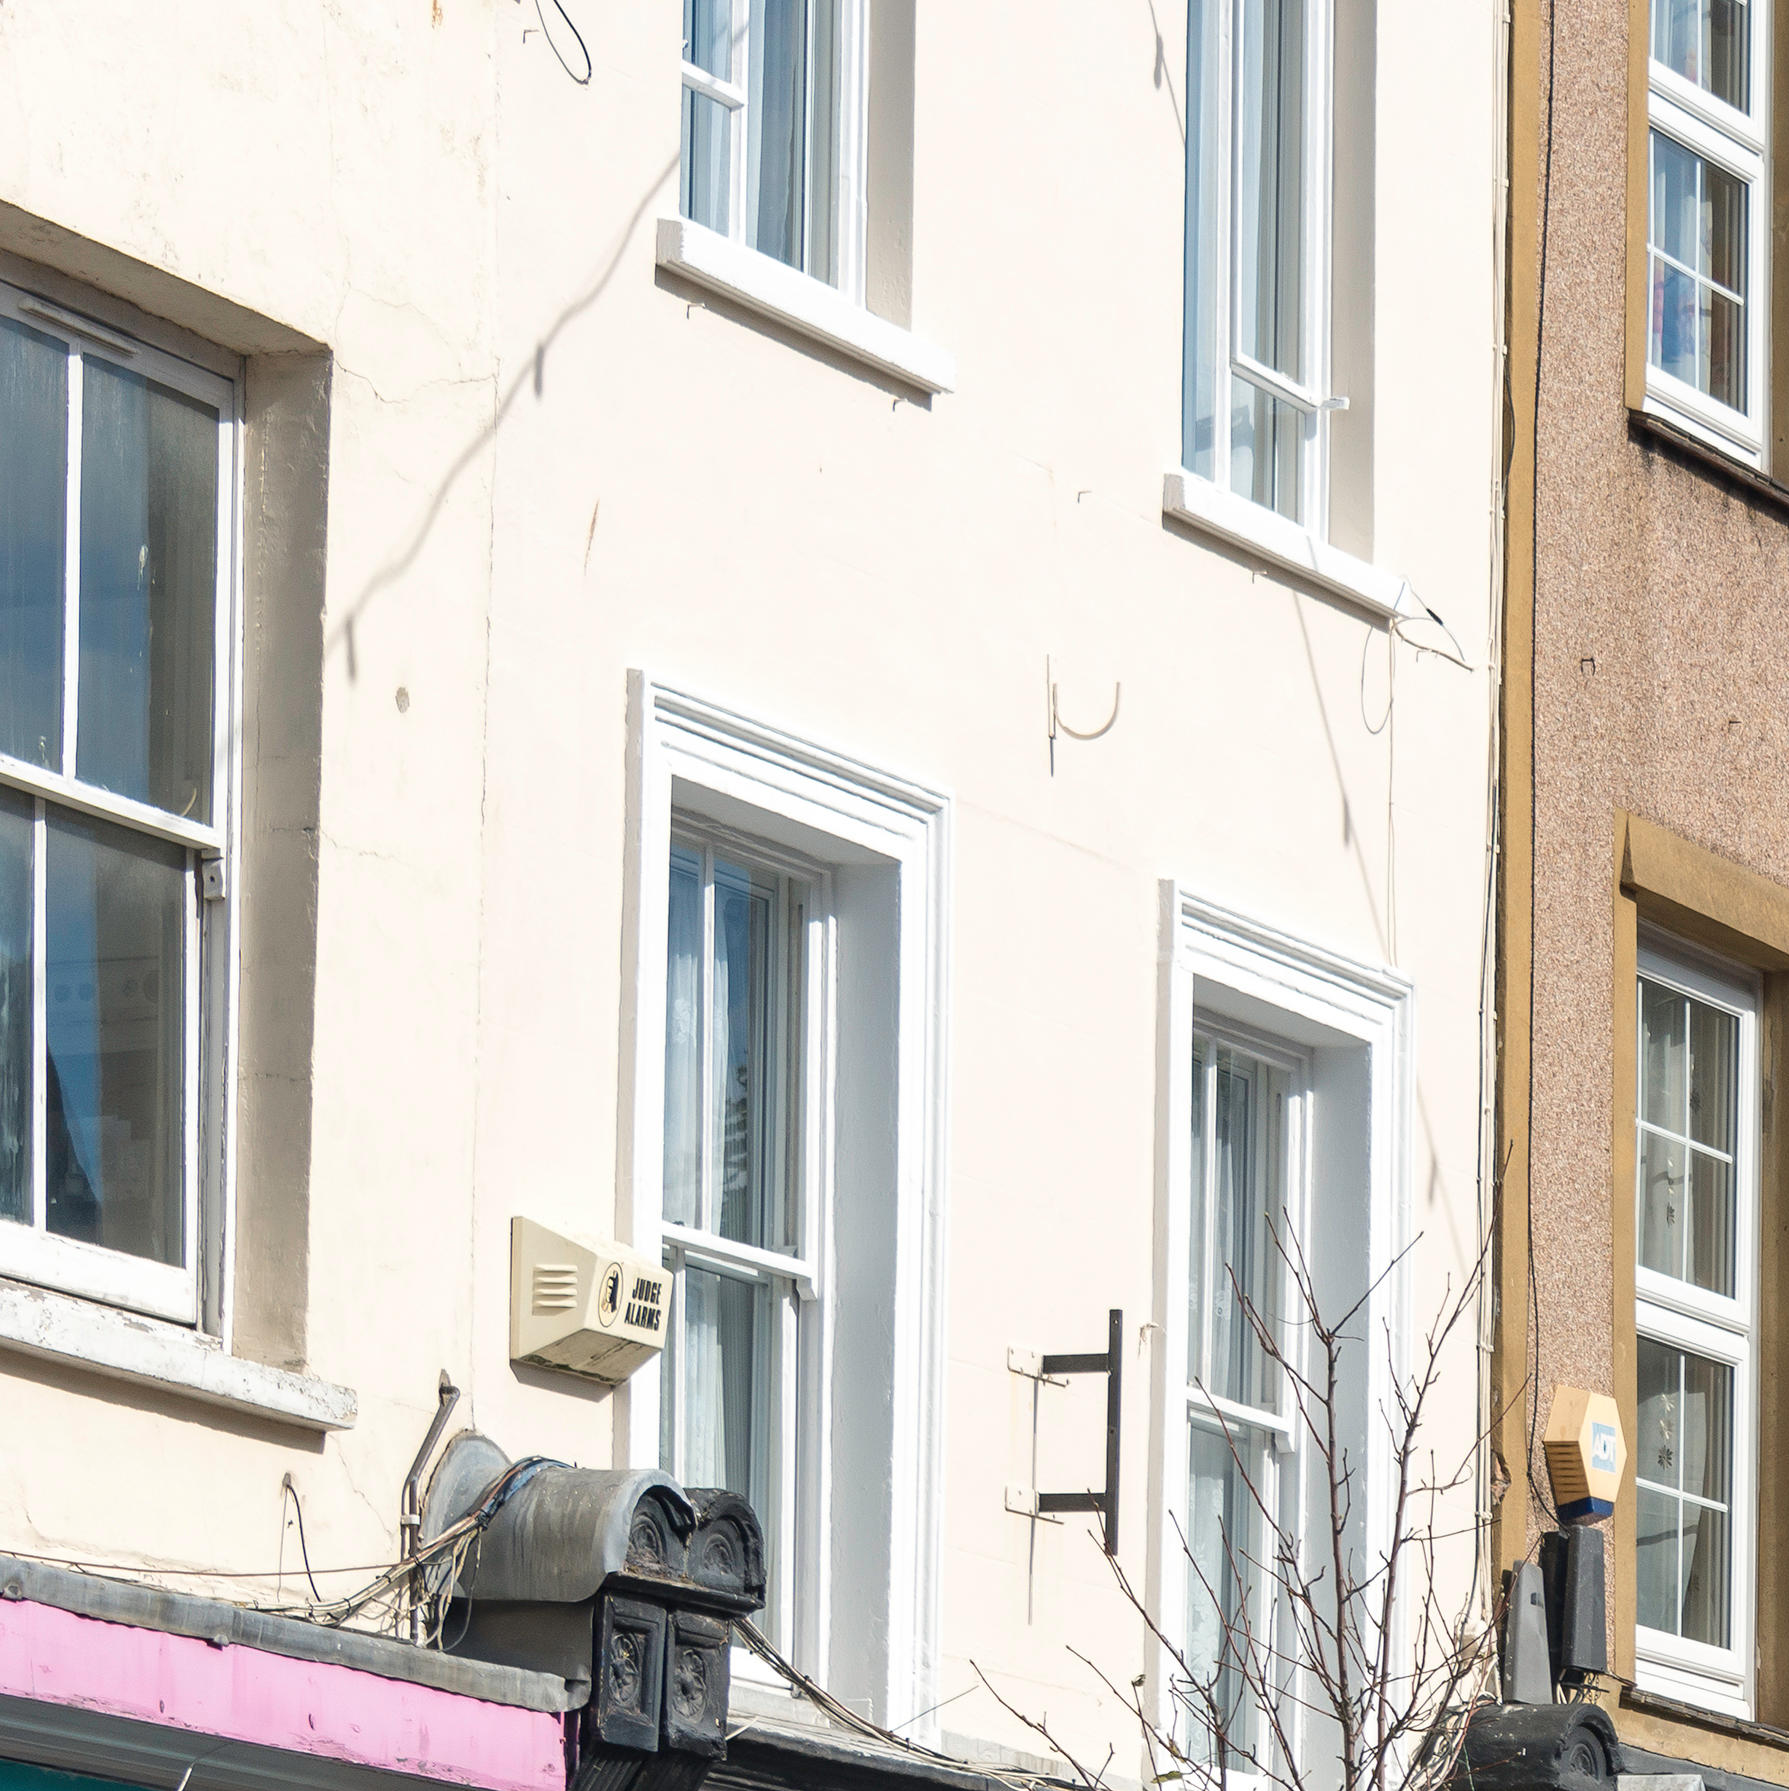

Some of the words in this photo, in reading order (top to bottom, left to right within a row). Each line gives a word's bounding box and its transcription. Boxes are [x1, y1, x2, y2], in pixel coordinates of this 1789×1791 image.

[632, 1277, 662, 1305] JUDGE
[624, 1303, 661, 1331] ALARMS
[1591, 1437, 1616, 1465] ADT
